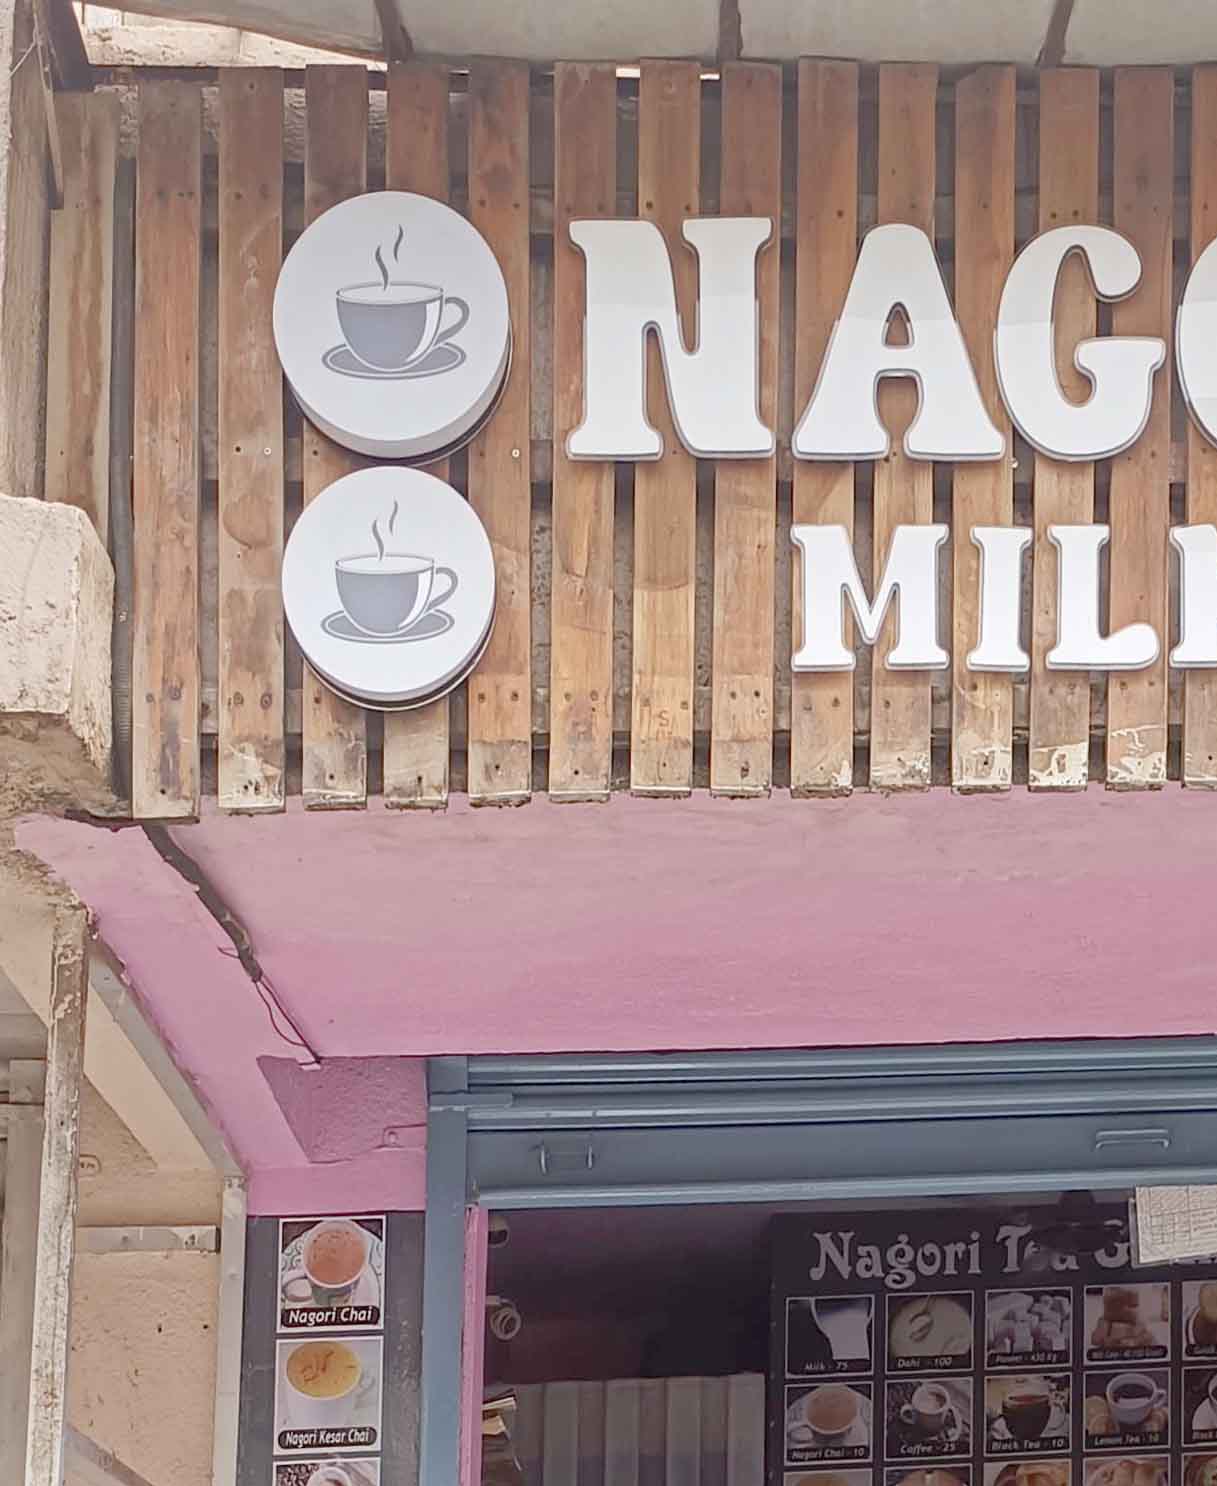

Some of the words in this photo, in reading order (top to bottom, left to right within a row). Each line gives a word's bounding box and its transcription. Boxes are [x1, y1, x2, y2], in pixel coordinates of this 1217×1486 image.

[809, 1231, 983, 1290] Nagori
[288, 1308, 338, 1327] Nagori
[340, 1306, 373, 1322] Chai
[286, 1430, 318, 1449] Nagori
[319, 1429, 347, 1444] Kesar
[348, 1427, 370, 1443] Chai
[991, 1439, 1018, 1450] Black
[1023, 1439, 1041, 1449] Tea
[900, 1442, 933, 1456] Coffee
